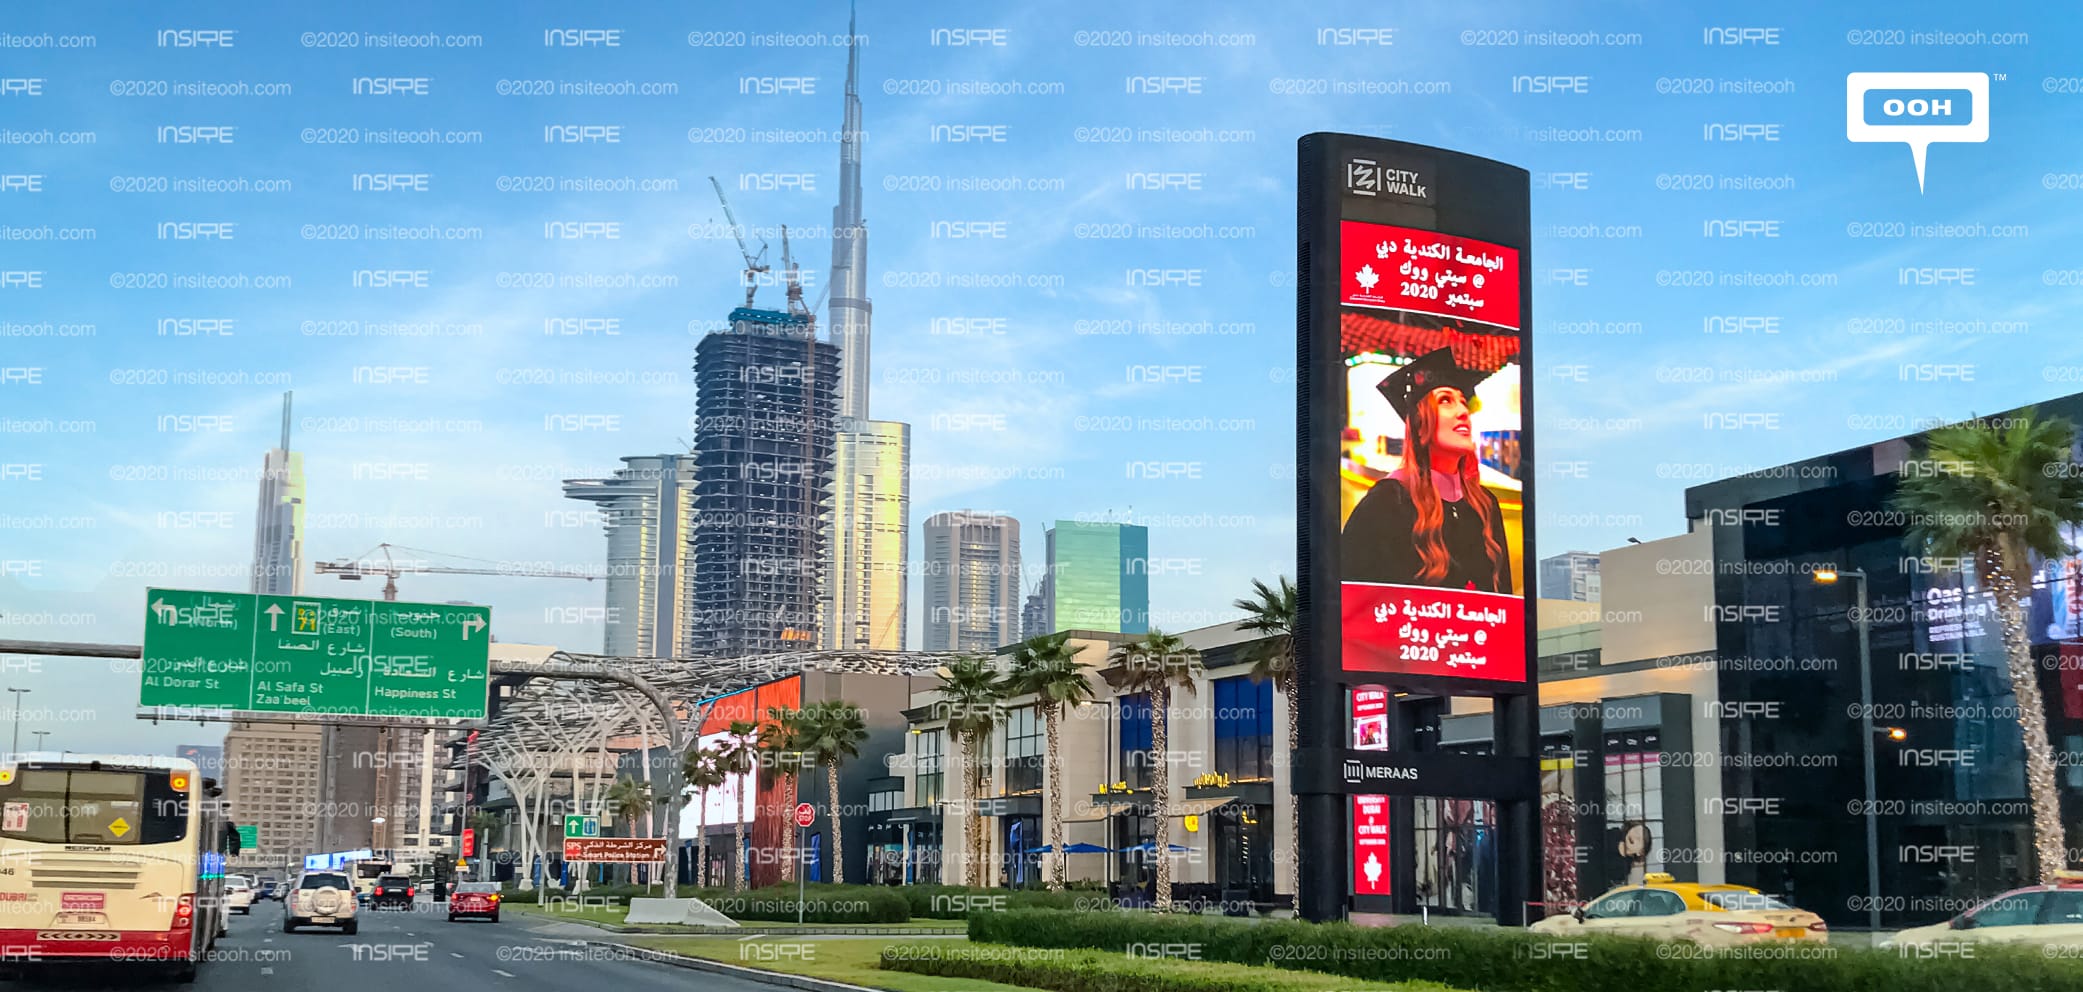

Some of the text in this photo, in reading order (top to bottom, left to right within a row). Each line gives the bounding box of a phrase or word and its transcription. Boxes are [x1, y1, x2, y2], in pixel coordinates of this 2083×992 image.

[1386, 168, 1418, 184] CITY
[1386, 181, 1427, 198] WALK
[1375, 240, 1397, 259] دبي
[1403, 238, 1451, 260] الكندية
[1399, 260, 1429, 281] ووك
[1435, 269, 1467, 288] سيتي
[1400, 282, 1485, 311] سبتمبر 2020
[1374, 602, 1397, 623] دبي
[1402, 599, 1452, 621] الكندية
[323, 623, 361, 637] (East)
[390, 626, 437, 640] (South)
[1398, 622, 1429, 643] ووك
[1435, 628, 1469, 649] سيتي
[278, 638, 366, 656] شارع الصفا
[1399, 645, 1487, 669] سبتمبر 2020
[145, 676, 220, 689] Al Dorar St
[447, 668, 485, 682] شارع
[257, 681, 324, 693] Al Safa St
[374, 686, 457, 699] Happiness St
[1366, 766, 1418, 780] MERAAS
